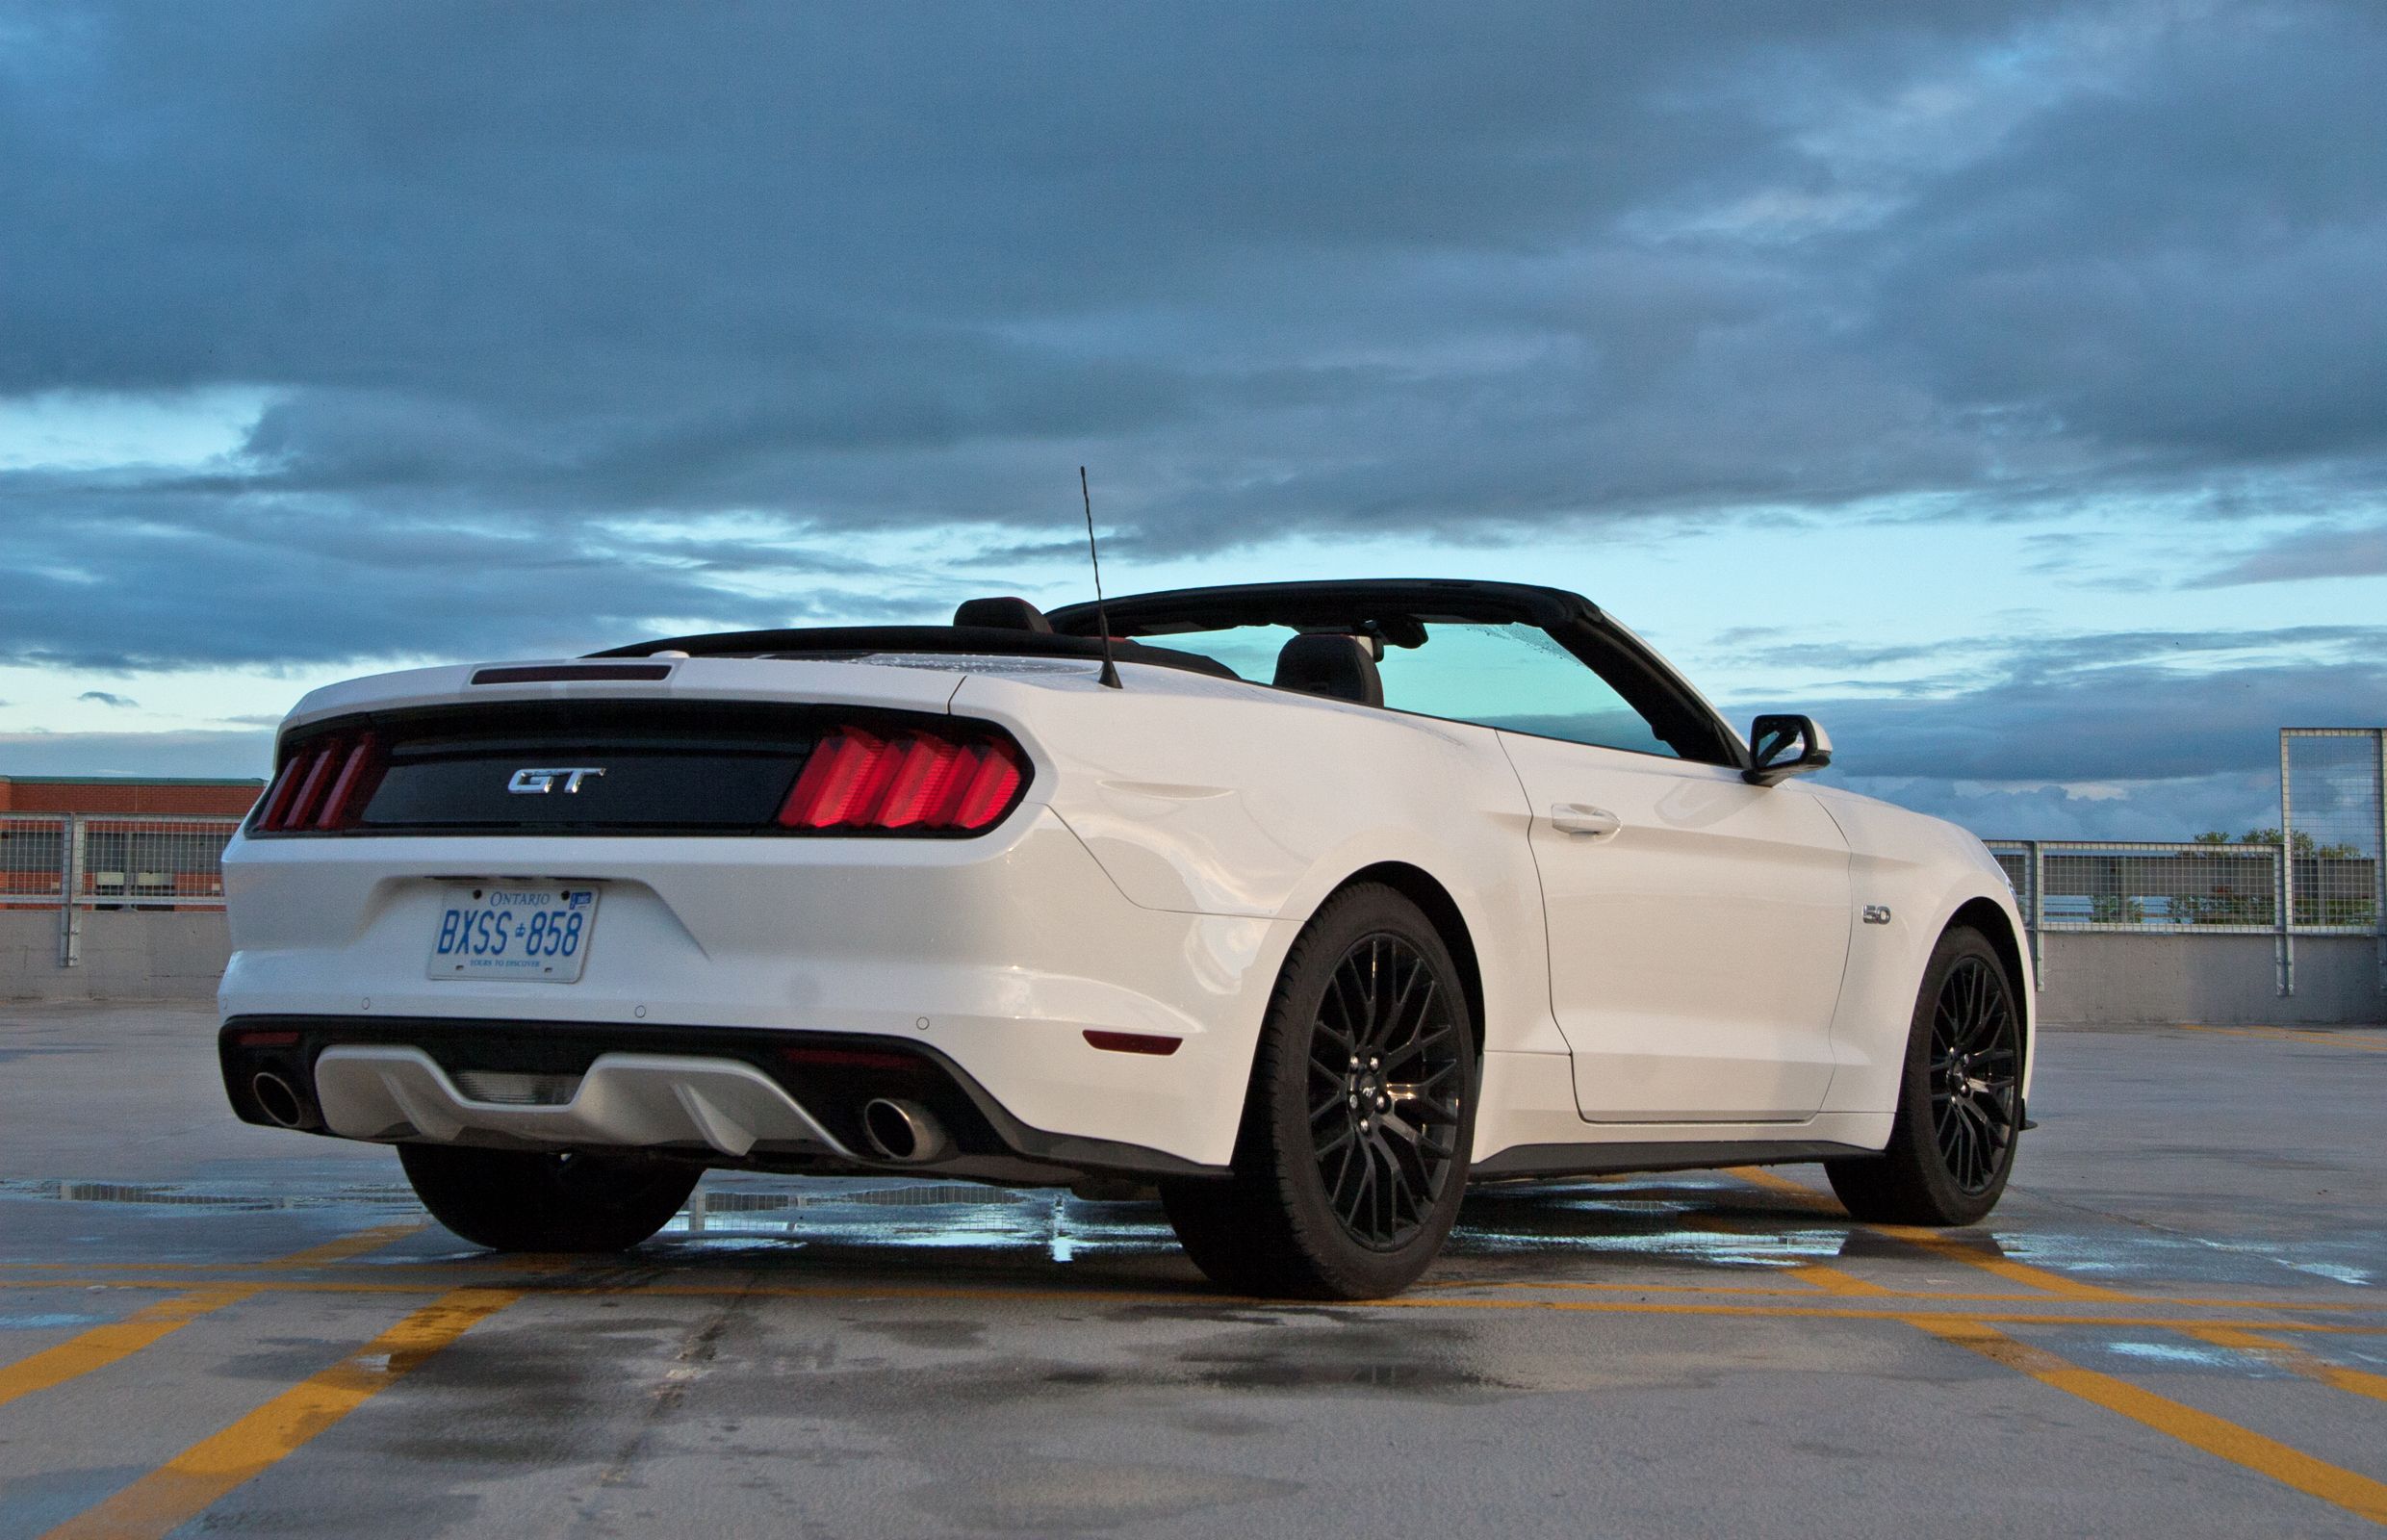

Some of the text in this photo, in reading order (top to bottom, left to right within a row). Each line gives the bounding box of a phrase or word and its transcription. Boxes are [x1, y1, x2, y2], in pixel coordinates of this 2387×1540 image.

[507, 767, 606, 793] GT
[489, 891, 551, 907] ONTARIO
[436, 910, 583, 956] BXSS 858
